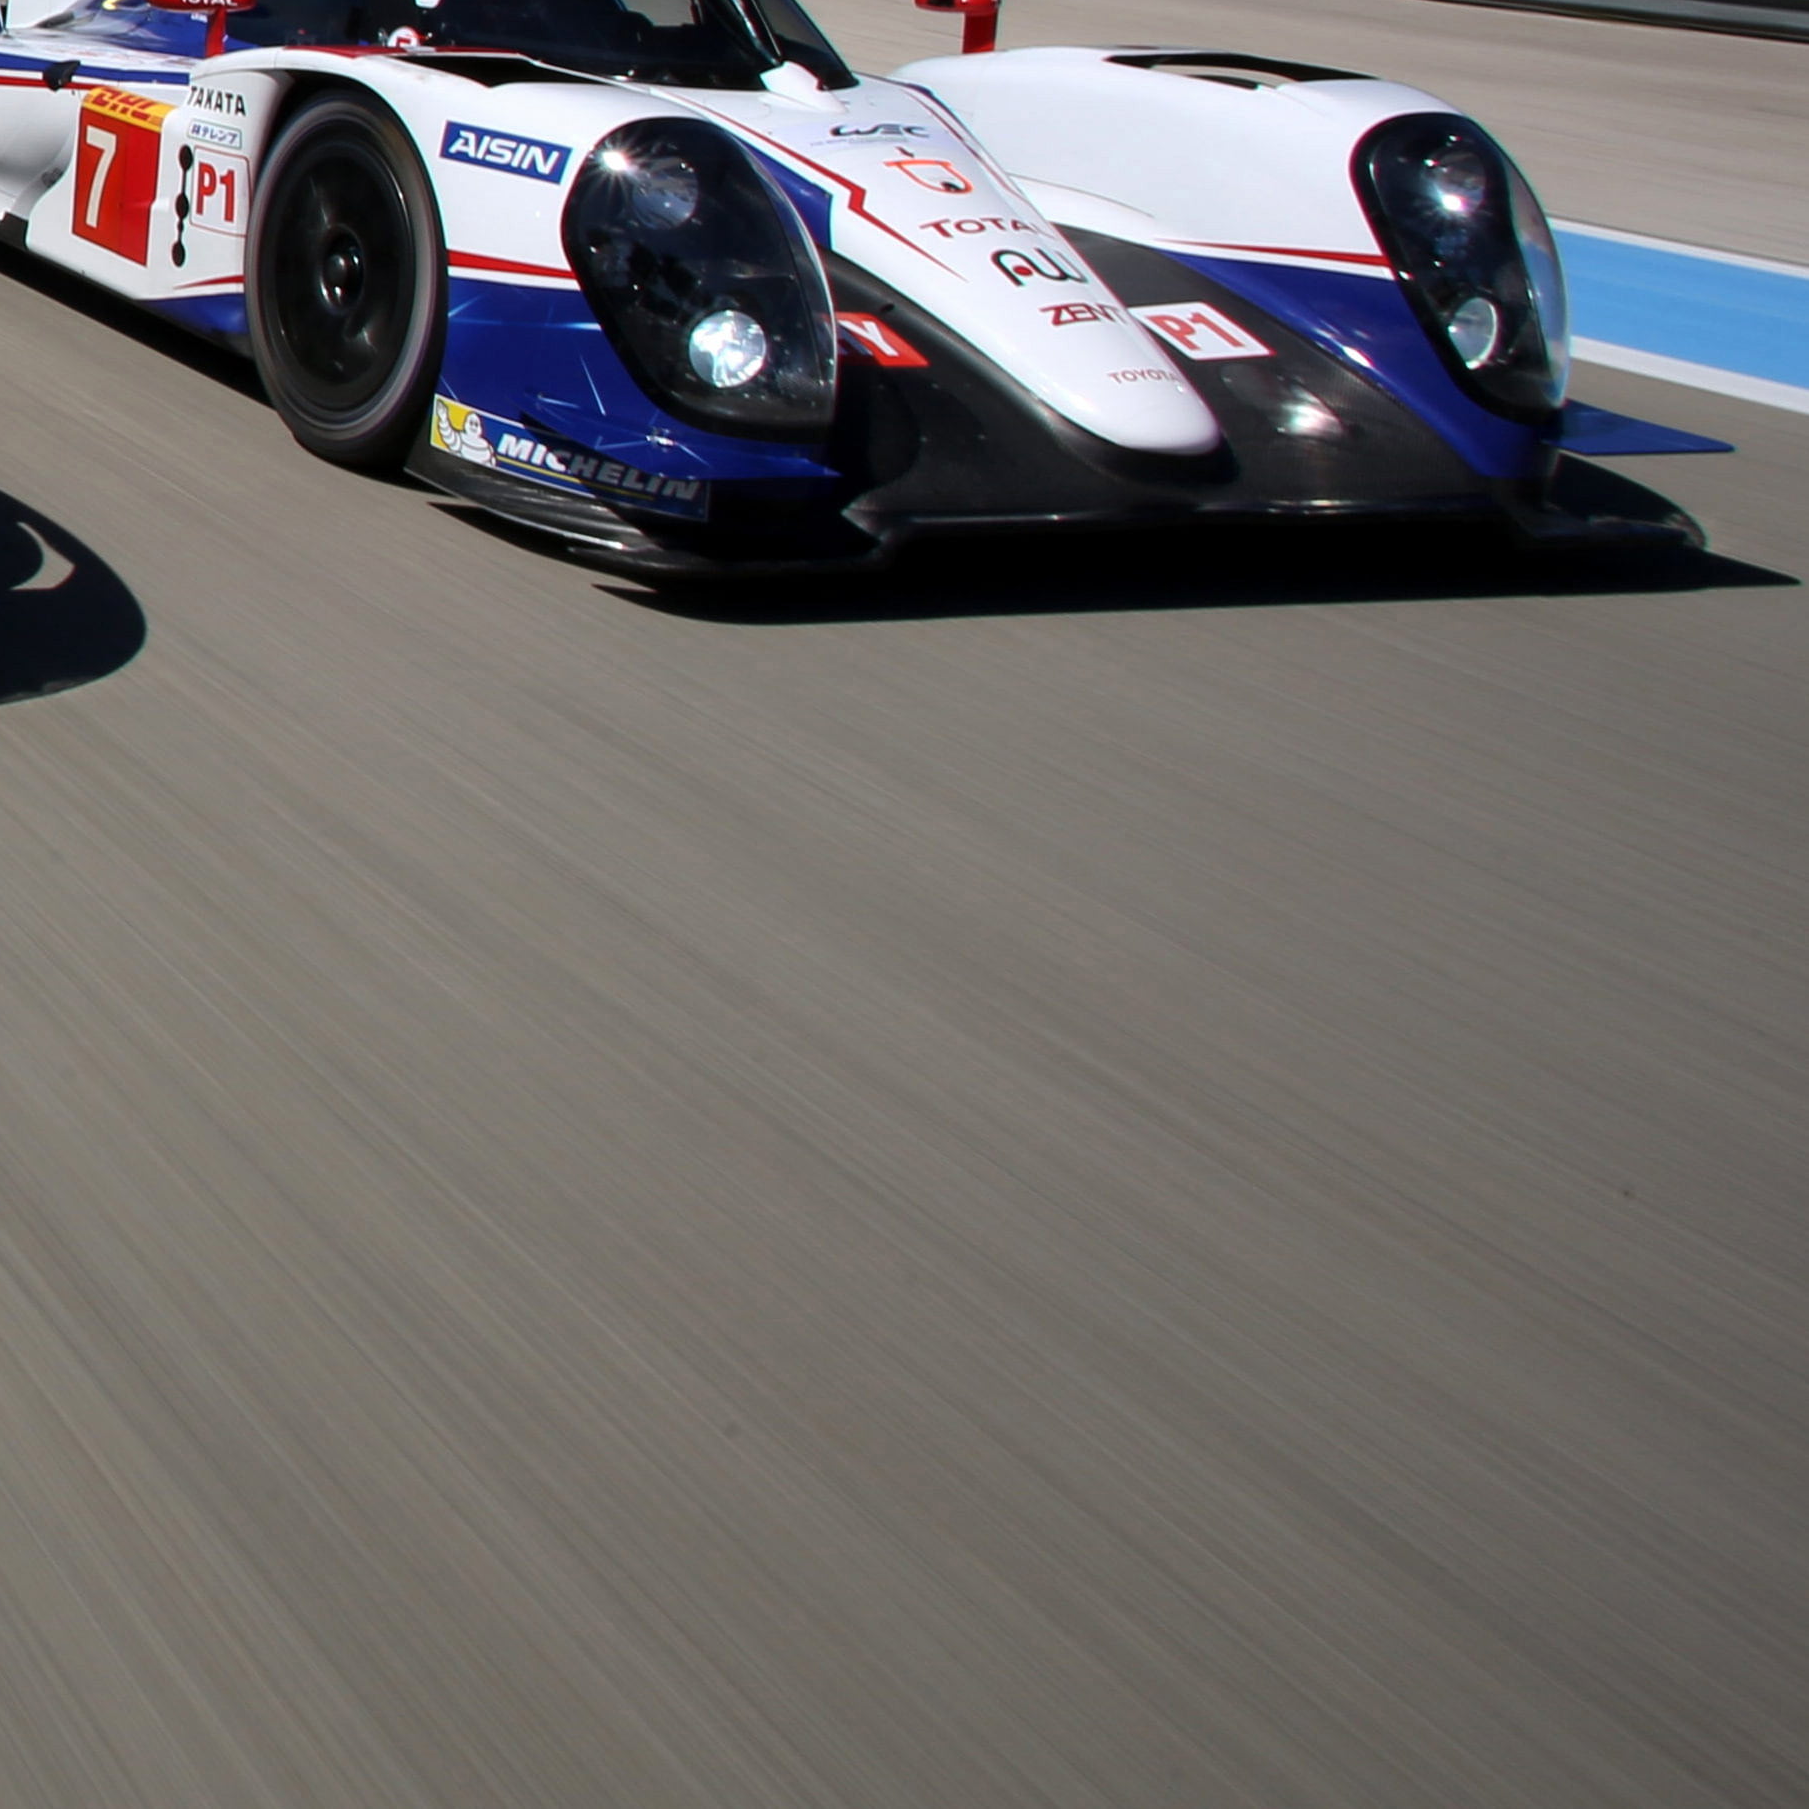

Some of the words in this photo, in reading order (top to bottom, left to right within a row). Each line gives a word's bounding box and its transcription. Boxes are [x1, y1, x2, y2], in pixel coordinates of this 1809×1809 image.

[187, 85, 247, 117] TAKATA
[447, 129, 560, 176] AISIN
[85, 124, 117, 229] 7
[196, 161, 235, 223] P1
[1037, 302, 1129, 326] ZENT
[1144, 311, 1246, 352] P1
[1107, 367, 1181, 385] TOYOTA
[496, 432, 701, 500] MICHELIN
